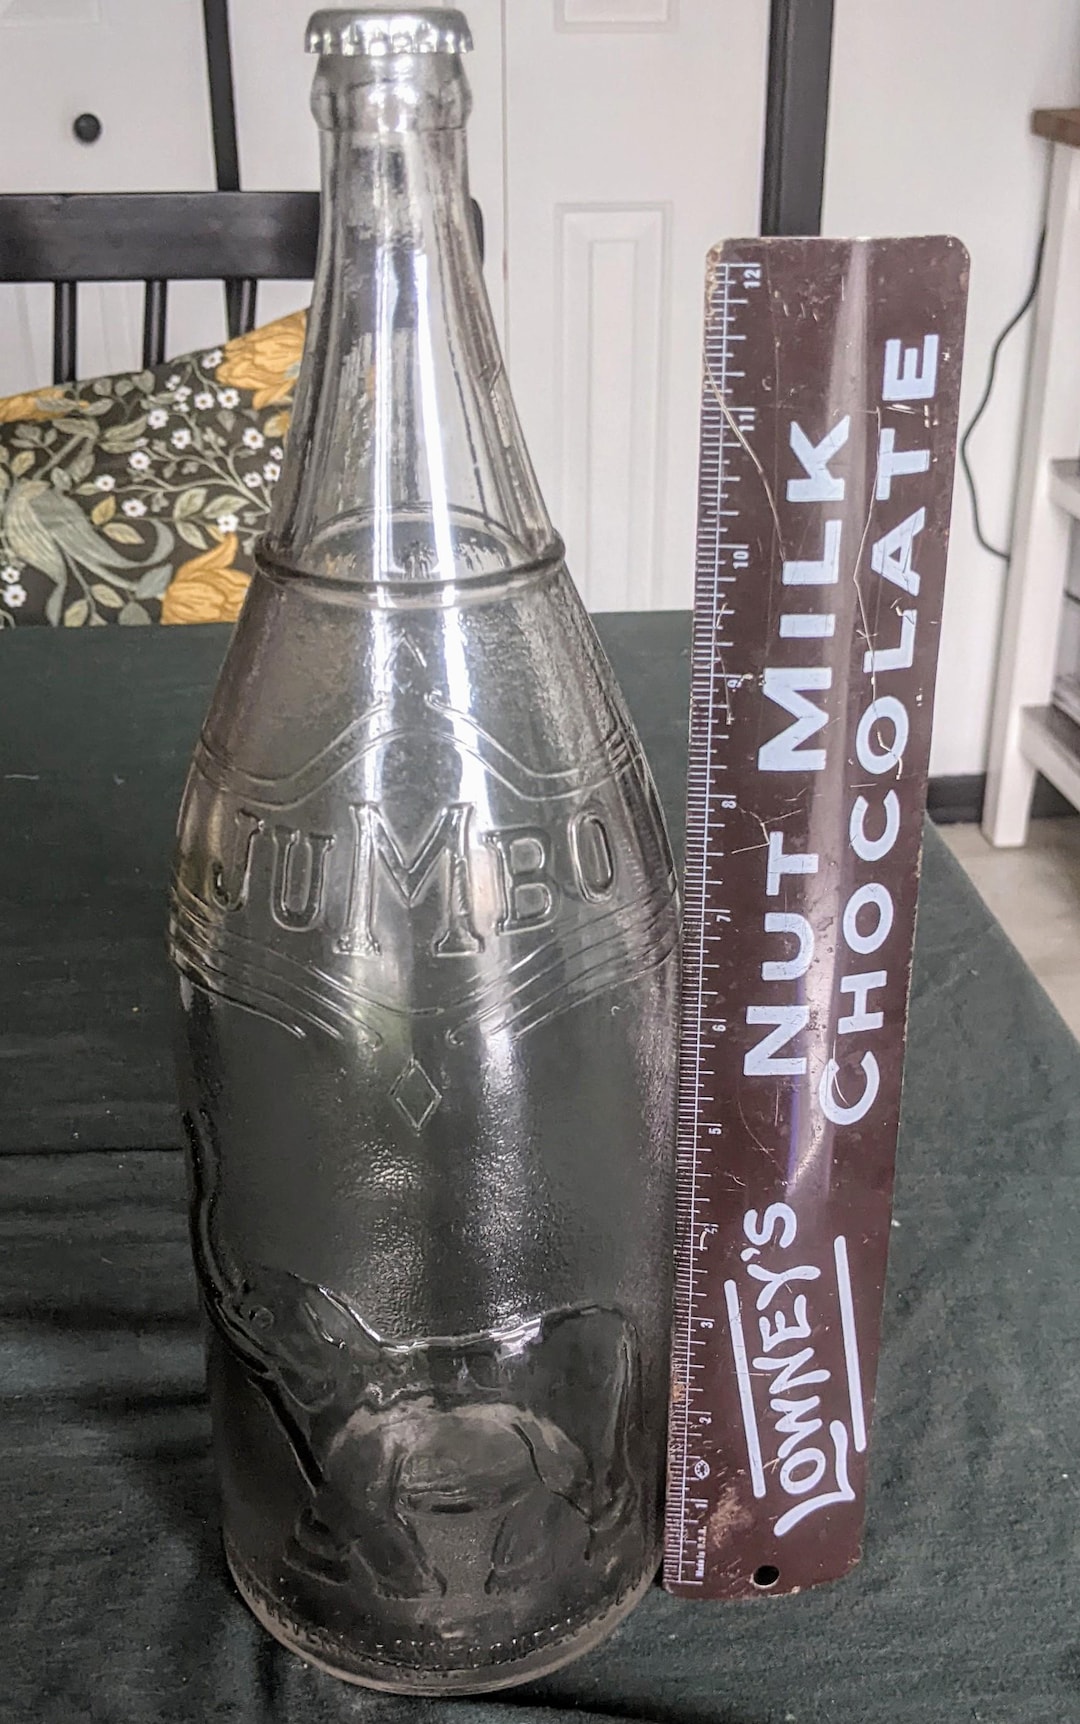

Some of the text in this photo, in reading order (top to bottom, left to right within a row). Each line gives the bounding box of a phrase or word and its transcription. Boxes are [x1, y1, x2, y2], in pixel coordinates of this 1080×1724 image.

[743, 268, 761, 289] 12
[738, 412, 755, 432] 11
[733, 548, 750, 569] 10
[818, 333, 939, 1126] CHOCOLATE
[743, 414, 850, 1076] NUT MILK
[721, 800, 737, 809] 8
[212, 802, 614, 957] JUMBO
[716, 914, 732, 923] 7
[711, 1024, 727, 1033] 6
[708, 1126, 723, 1136] 5
[700, 1320, 714, 1329] 3
[740, 1202, 857, 1537] LOWNEY'S
[699, 1416, 712, 1425] 2
